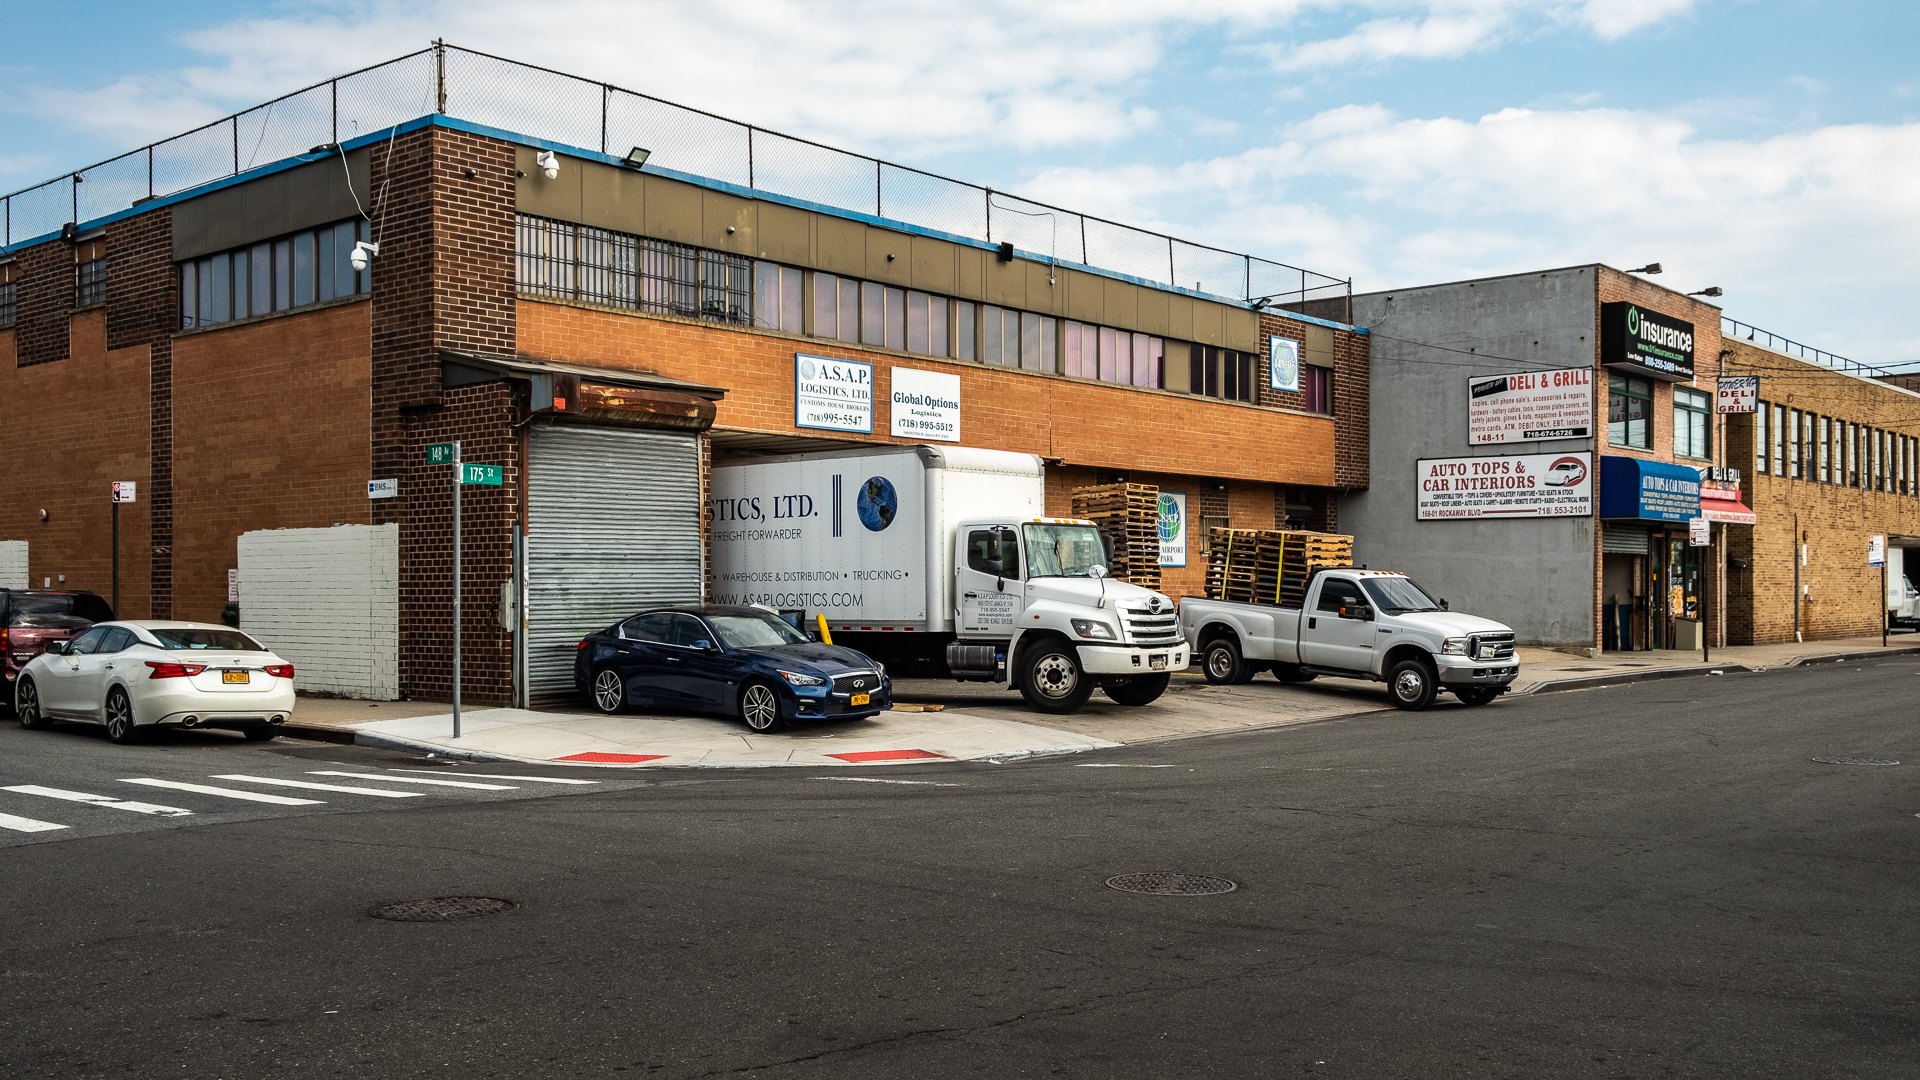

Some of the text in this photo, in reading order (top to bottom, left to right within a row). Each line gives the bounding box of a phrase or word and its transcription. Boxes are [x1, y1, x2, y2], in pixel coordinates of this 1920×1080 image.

[1641, 314, 1692, 352] insurance
[819, 364, 870, 385] A.S.A.P.
[1510, 375, 1535, 391] DELI
[1541, 373, 1548, 388] &
[1554, 370, 1589, 387] GRILL
[800, 383, 870, 400] LOGISTICS, LTD.
[1718, 379, 1744, 390] POWER
[893, 391, 958, 410] Global Options
[1533, 394, 1561, 402] accessories
[1720, 390, 1754, 398] DELI
[800, 399, 826, 407] CUSTOMS
[846, 404, 870, 412] BROKERS
[1719, 405, 1754, 413] GRILL
[911, 409, 942, 417] Logistics
[1503, 414, 1517, 422] gloves
[1534, 412, 1557, 420] magazines
[899, 418, 953, 432] (718) 995-5512
[1518, 421, 1534, 429] DEBIT
[1477, 433, 1504, 442] 148-11
[432, 446, 449, 461] 148 Av
[470, 467, 493, 482] 175 St
[1430, 461, 1525, 477] AUTO TOPS &
[375, 482, 386, 491] BNS
[1423, 475, 1535, 492] CAR INTERIORS
[1642, 476, 1654, 489] AUTO
[1655, 477, 1664, 490] TOPS
[1669, 479, 1677, 492] CAR
[1678, 480, 1699, 495] INTERIORS
[773, 494, 818, 518] LTD.
[1439, 509, 1466, 517] ROCKAWAY
[1555, 506, 1587, 514] 553-2101
[713, 528, 802, 542] FREIGHT FORWARDER
[722, 569, 902, 582] WAREHOUSE & DISTRIBUTION TRUCKING
